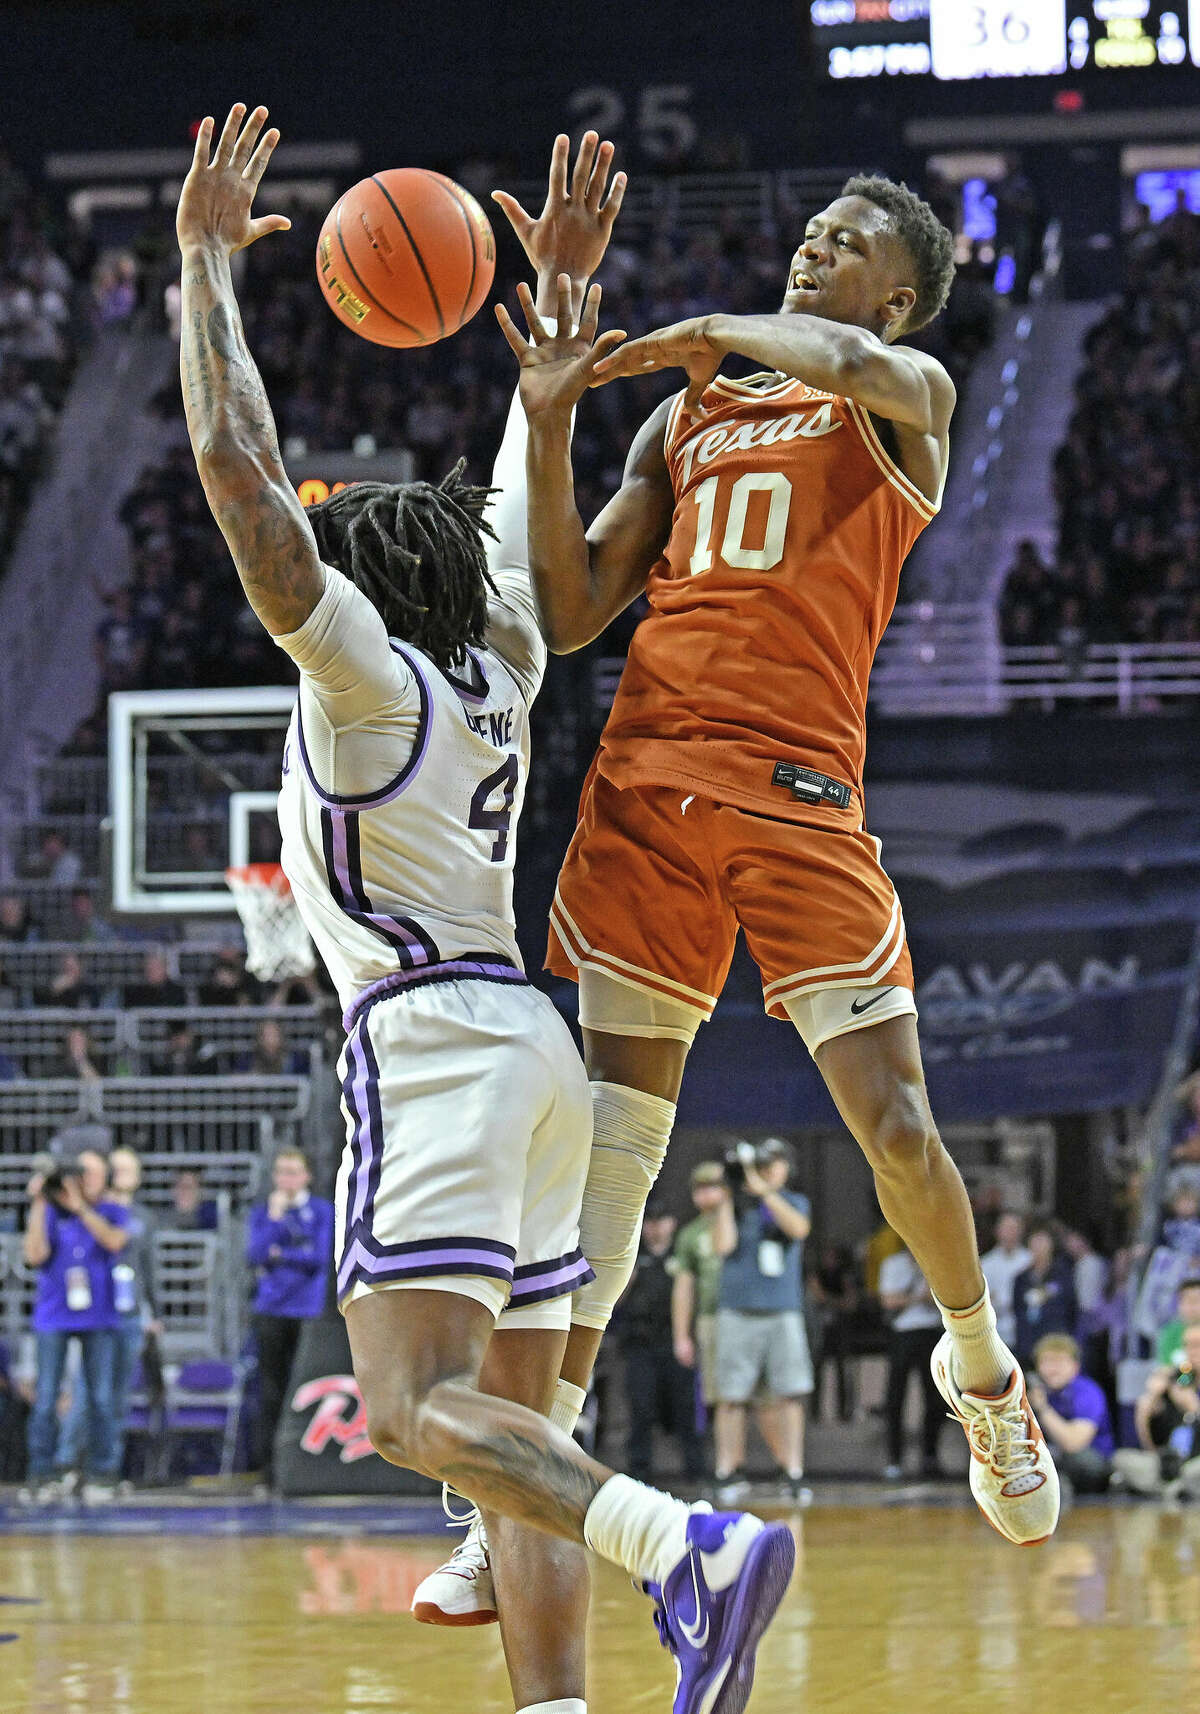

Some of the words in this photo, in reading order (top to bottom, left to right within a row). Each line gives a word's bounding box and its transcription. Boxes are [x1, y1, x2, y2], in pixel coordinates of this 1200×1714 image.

[967, 6, 1031, 47] 36
[674, 402, 843, 493] Texas
[689, 471, 793, 577] 10
[468, 753, 519, 863] 4
[827, 785, 840, 797] 44
